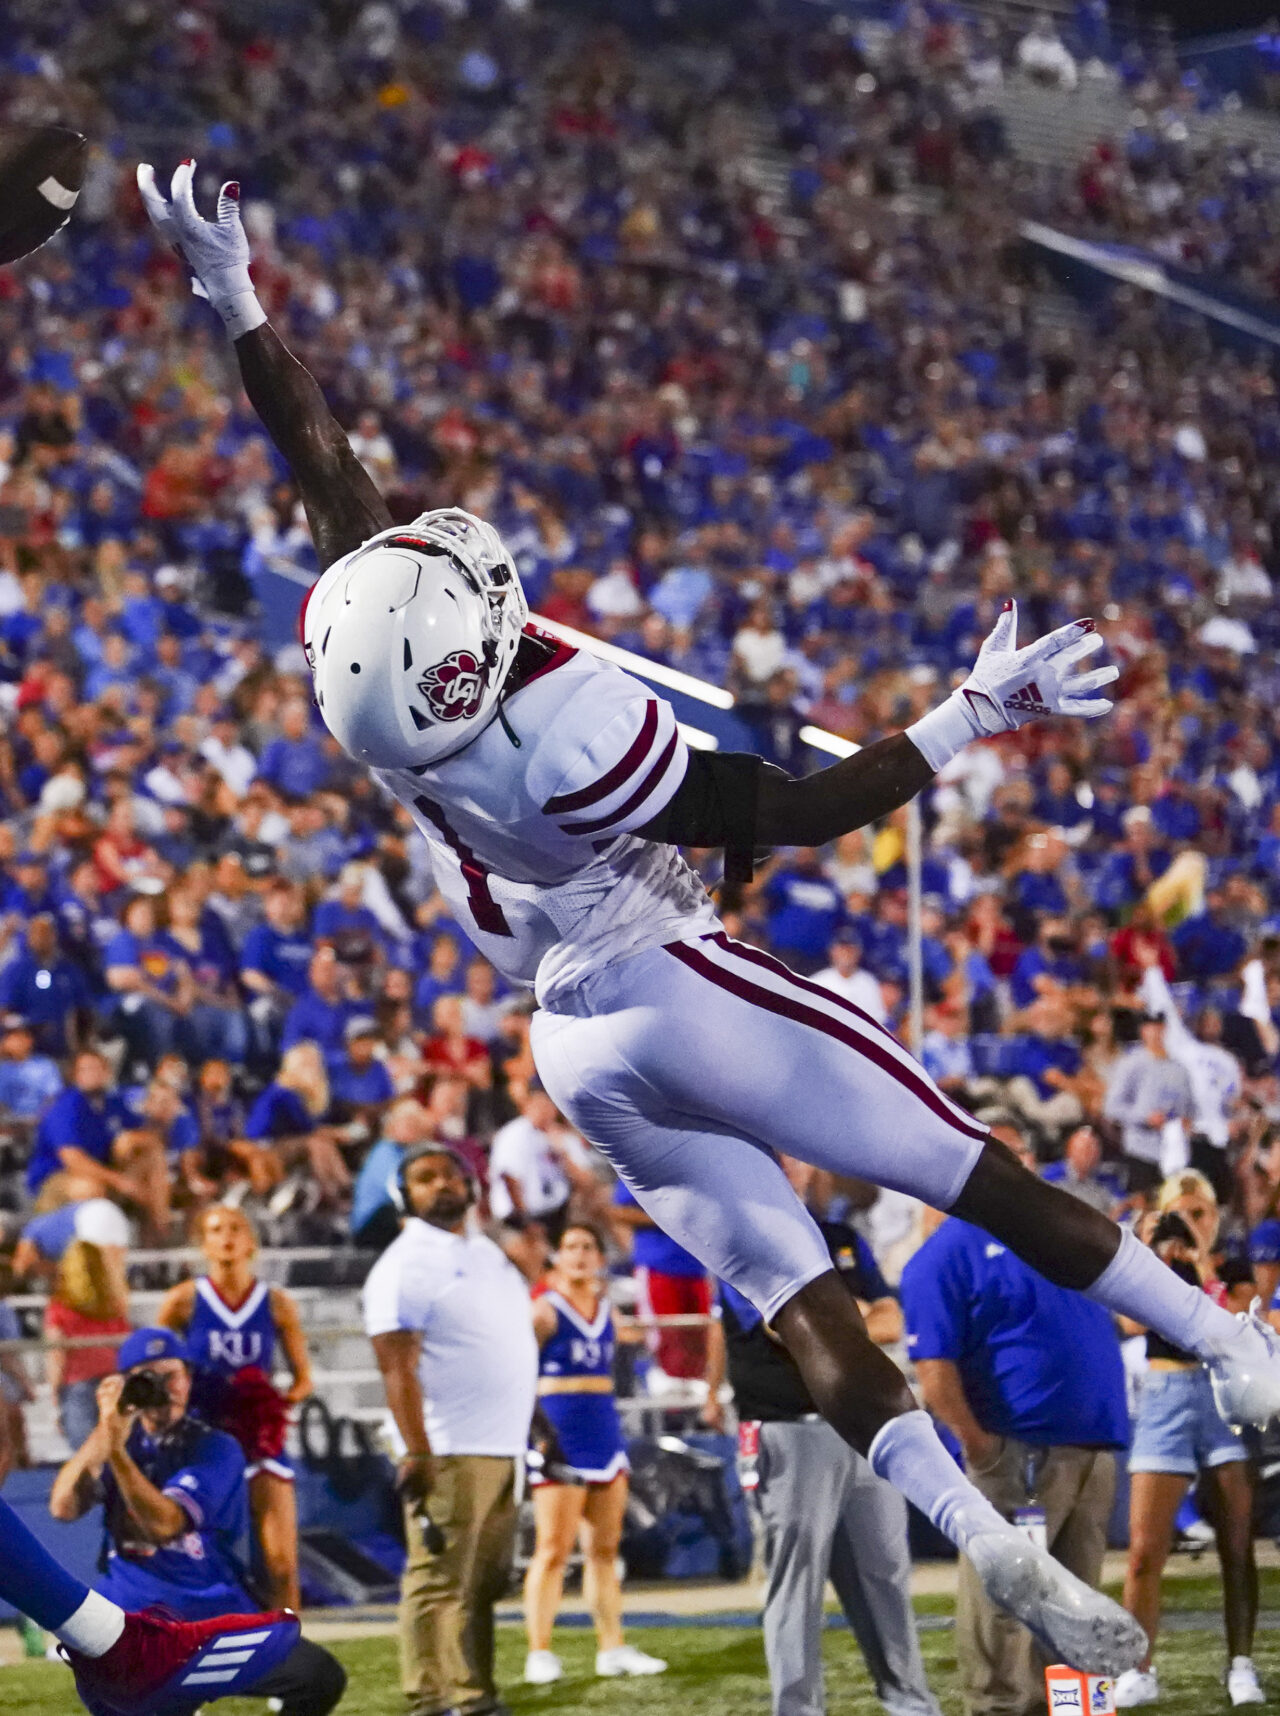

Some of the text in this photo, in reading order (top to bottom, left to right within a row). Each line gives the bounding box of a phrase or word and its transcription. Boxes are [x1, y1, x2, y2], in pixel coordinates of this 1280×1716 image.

[1003, 700, 1052, 715] adidas
[413, 794, 517, 938] 1
[208, 1330, 262, 1367] KU
